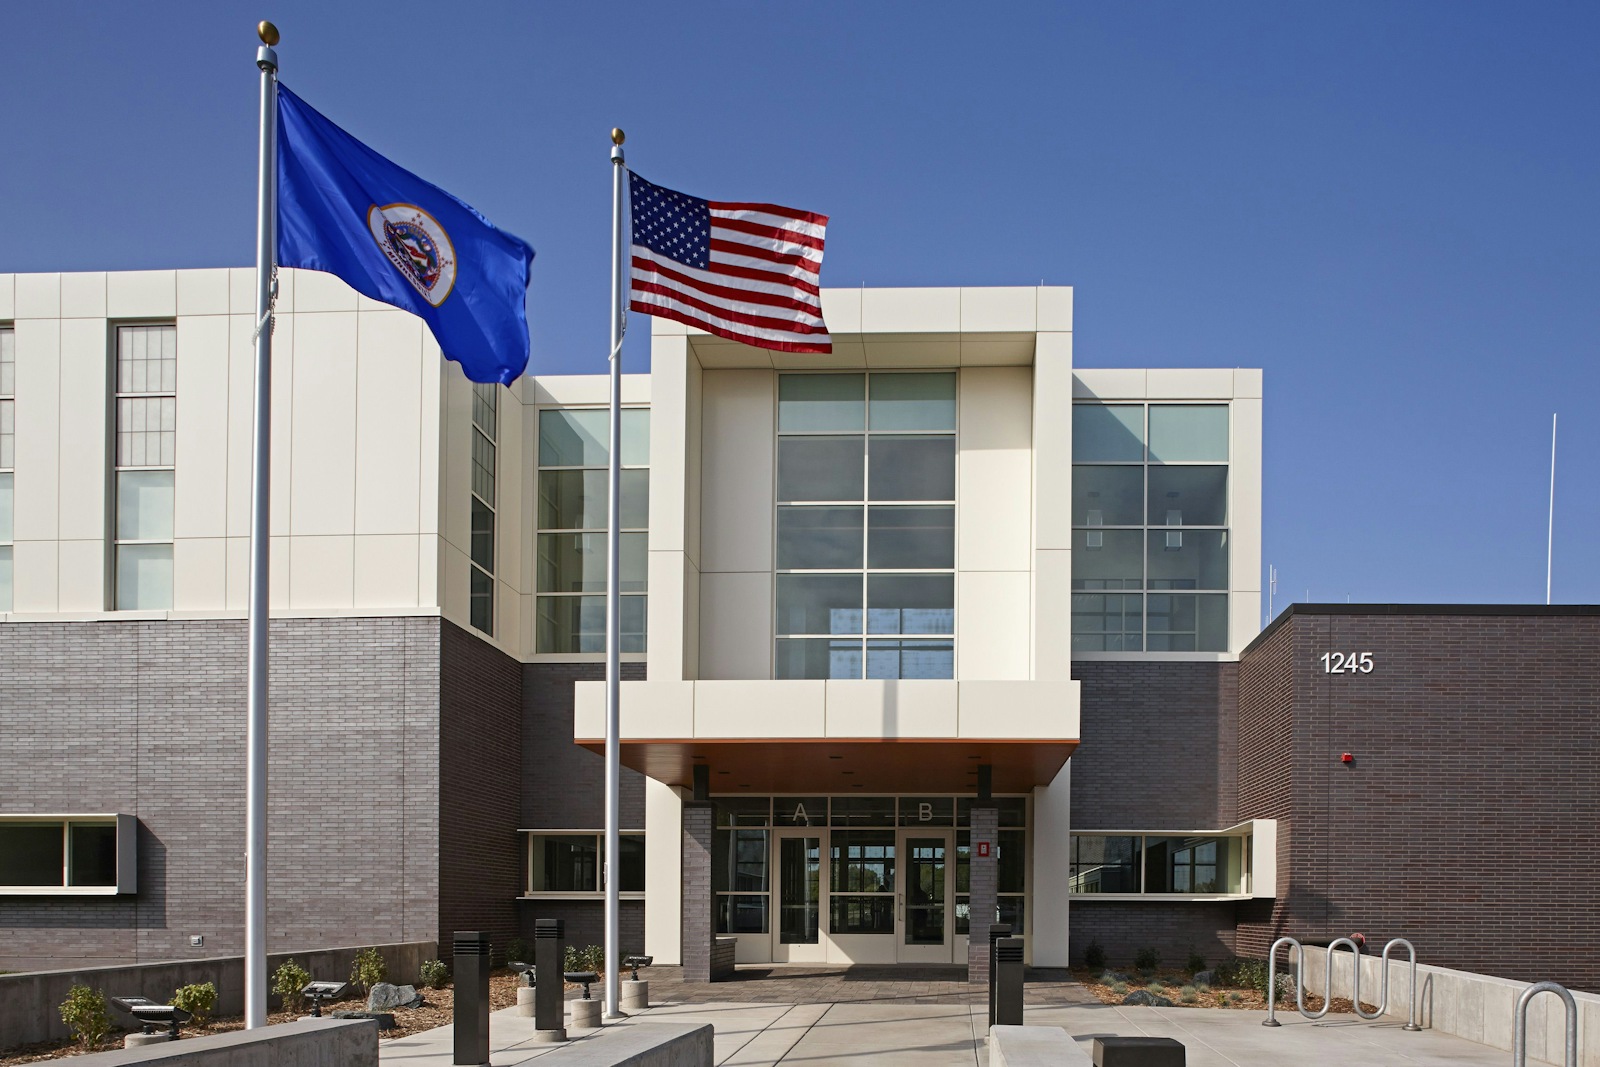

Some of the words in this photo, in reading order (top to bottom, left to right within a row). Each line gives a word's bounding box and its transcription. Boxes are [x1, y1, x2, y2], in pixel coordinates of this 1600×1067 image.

[1320, 652, 1374, 674] 1245
[792, 802, 809, 822] A
[918, 802, 933, 822] B
